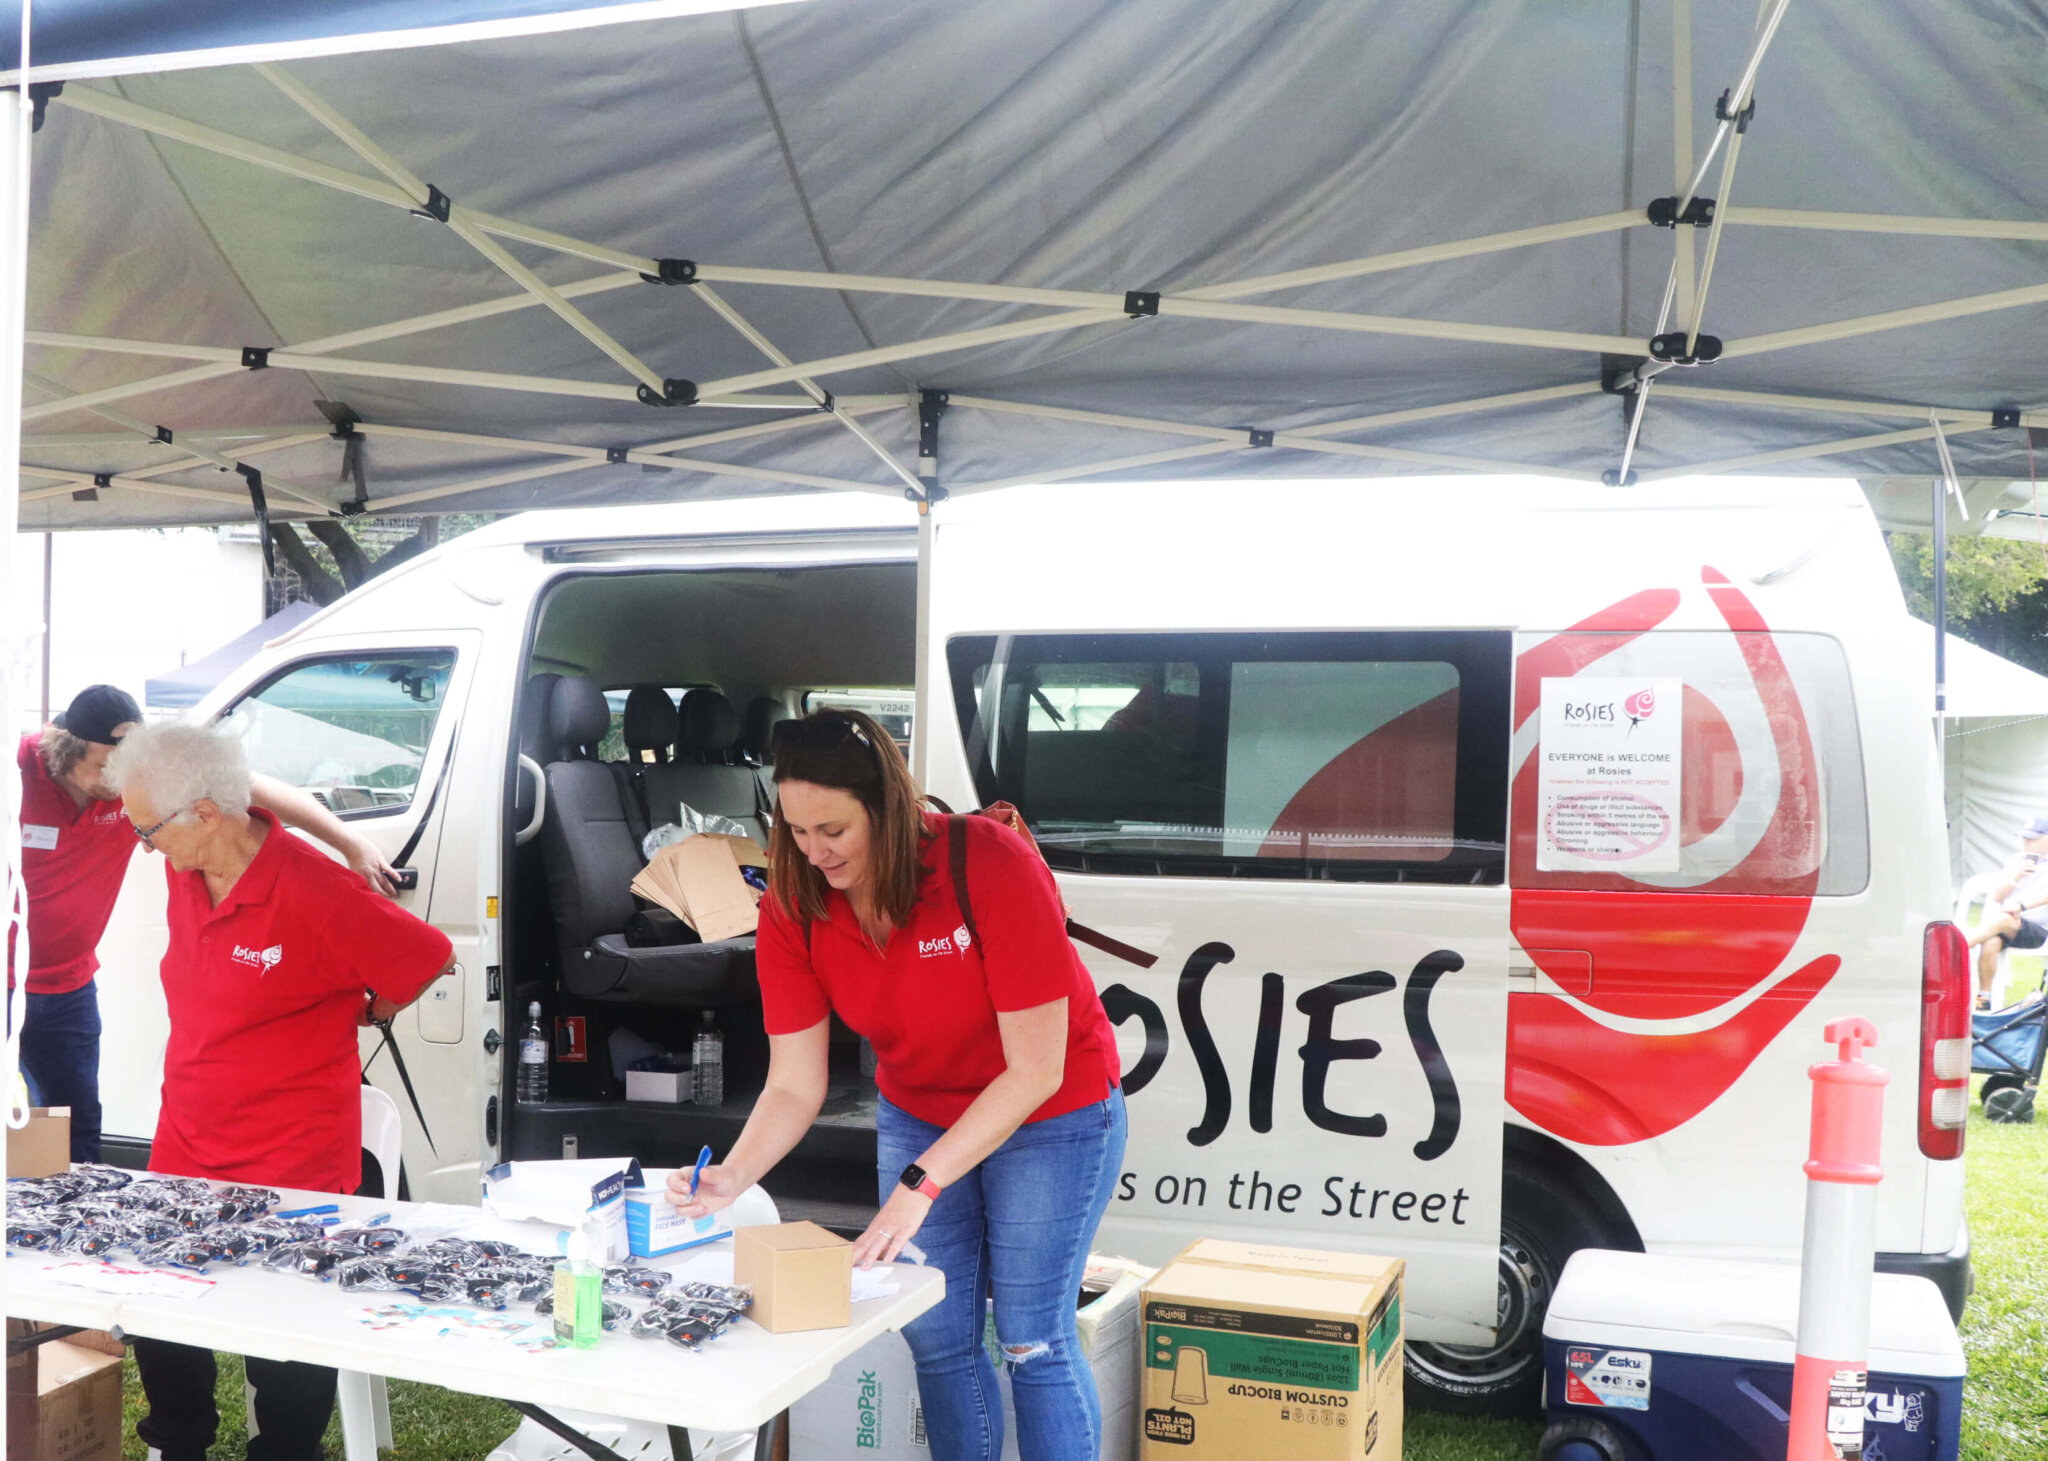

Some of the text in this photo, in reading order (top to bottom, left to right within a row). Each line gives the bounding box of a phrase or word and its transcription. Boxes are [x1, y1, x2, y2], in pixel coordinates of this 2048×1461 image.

[880, 703, 910, 713] V2242
[1564, 703, 1615, 721] ROSIES
[1548, 753, 1671, 763] EVERYONE is WELCOME
[1586, 766, 1632, 775] at Rosies
[919, 937, 953, 953] ROSIES
[1100, 941, 1465, 1161] OSIES
[1154, 1175, 1207, 1206] on
[1227, 1170, 1302, 1213] the
[1321, 1176, 1470, 1225] Street
[1154, 1308, 1187, 1321] BioPak
[1258, 1355, 1350, 1374] Hot Paper BioCups
[1570, 1351, 1595, 1364] 65L
[1607, 1356, 1642, 1369] Esky
[1230, 1362, 1350, 1384] 12oz (80mm) Single Wall
[1228, 1384, 1349, 1408] CUSTOM BIOCUP
[856, 1370, 877, 1448] BioPak
[1152, 1413, 1193, 1426] NOT OIL
[1147, 1420, 1193, 1435] PLANTS
